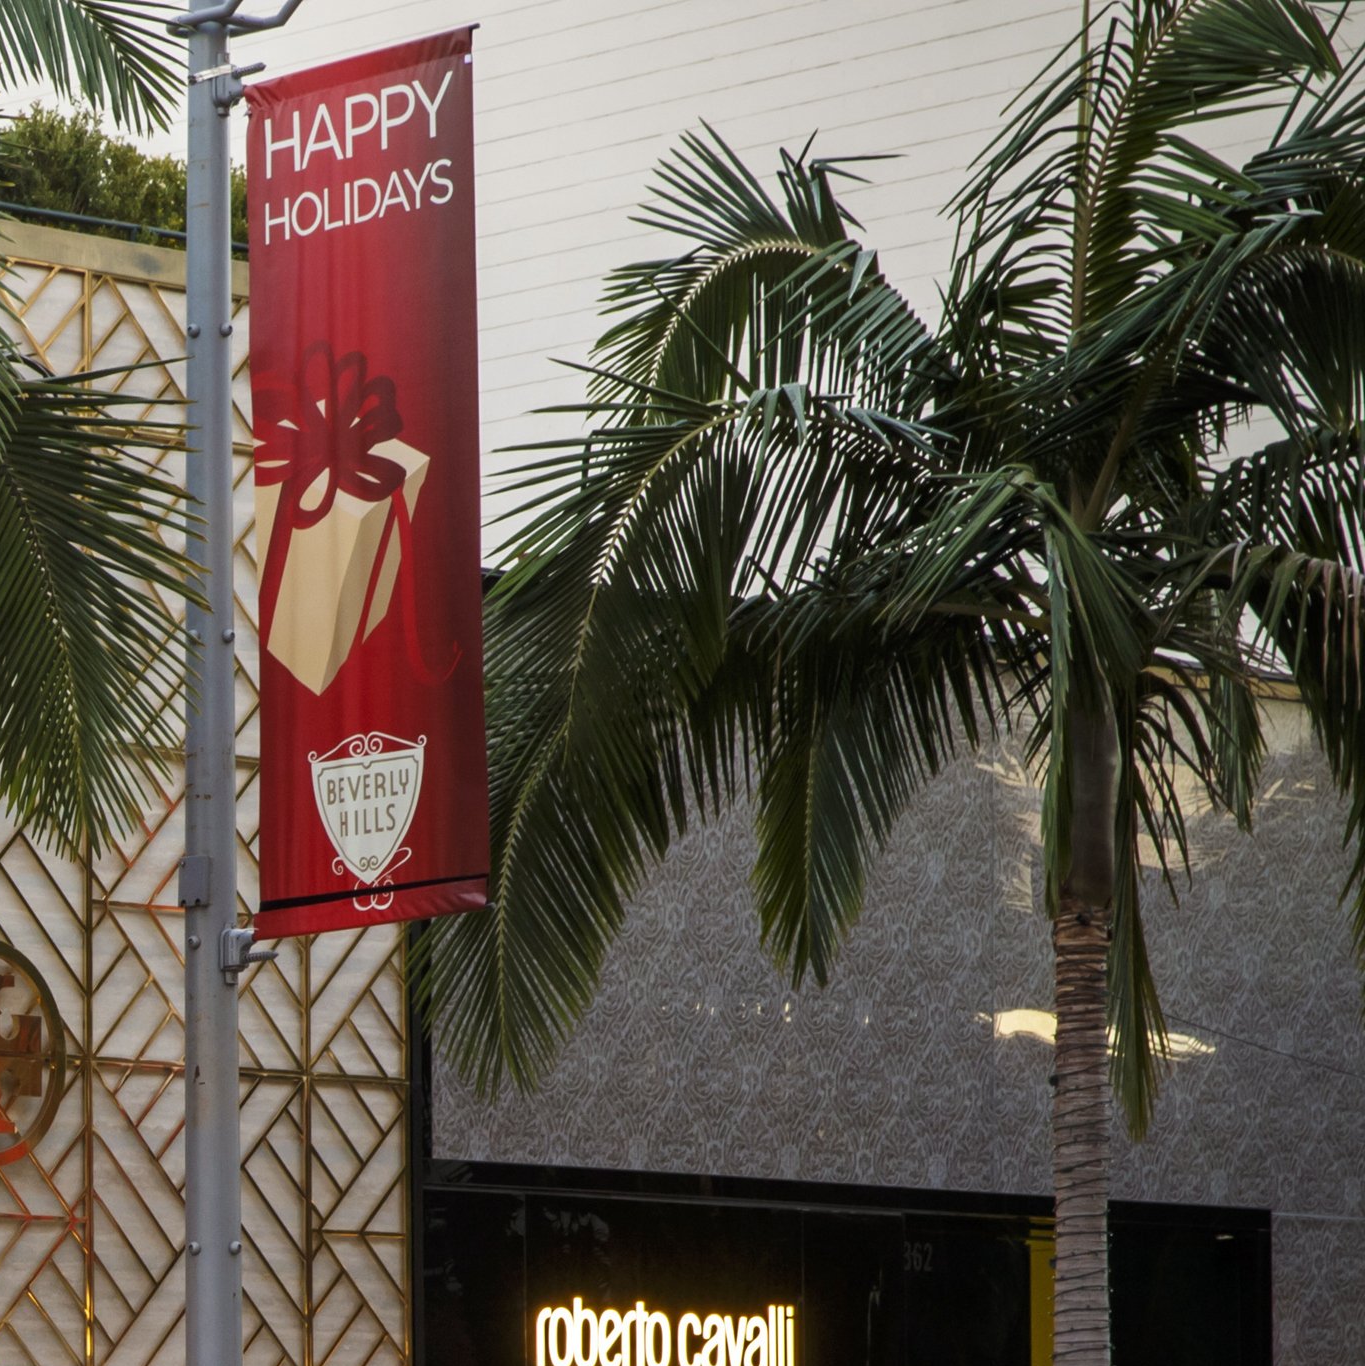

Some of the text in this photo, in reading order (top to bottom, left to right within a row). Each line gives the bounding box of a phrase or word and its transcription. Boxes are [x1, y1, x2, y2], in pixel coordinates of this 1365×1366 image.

[264, 70, 454, 180] HAPPY
[264, 158, 455, 246] HOLIDAYS
[326, 768, 410, 806] BEVERLY
[339, 803, 397, 838] HILLS
